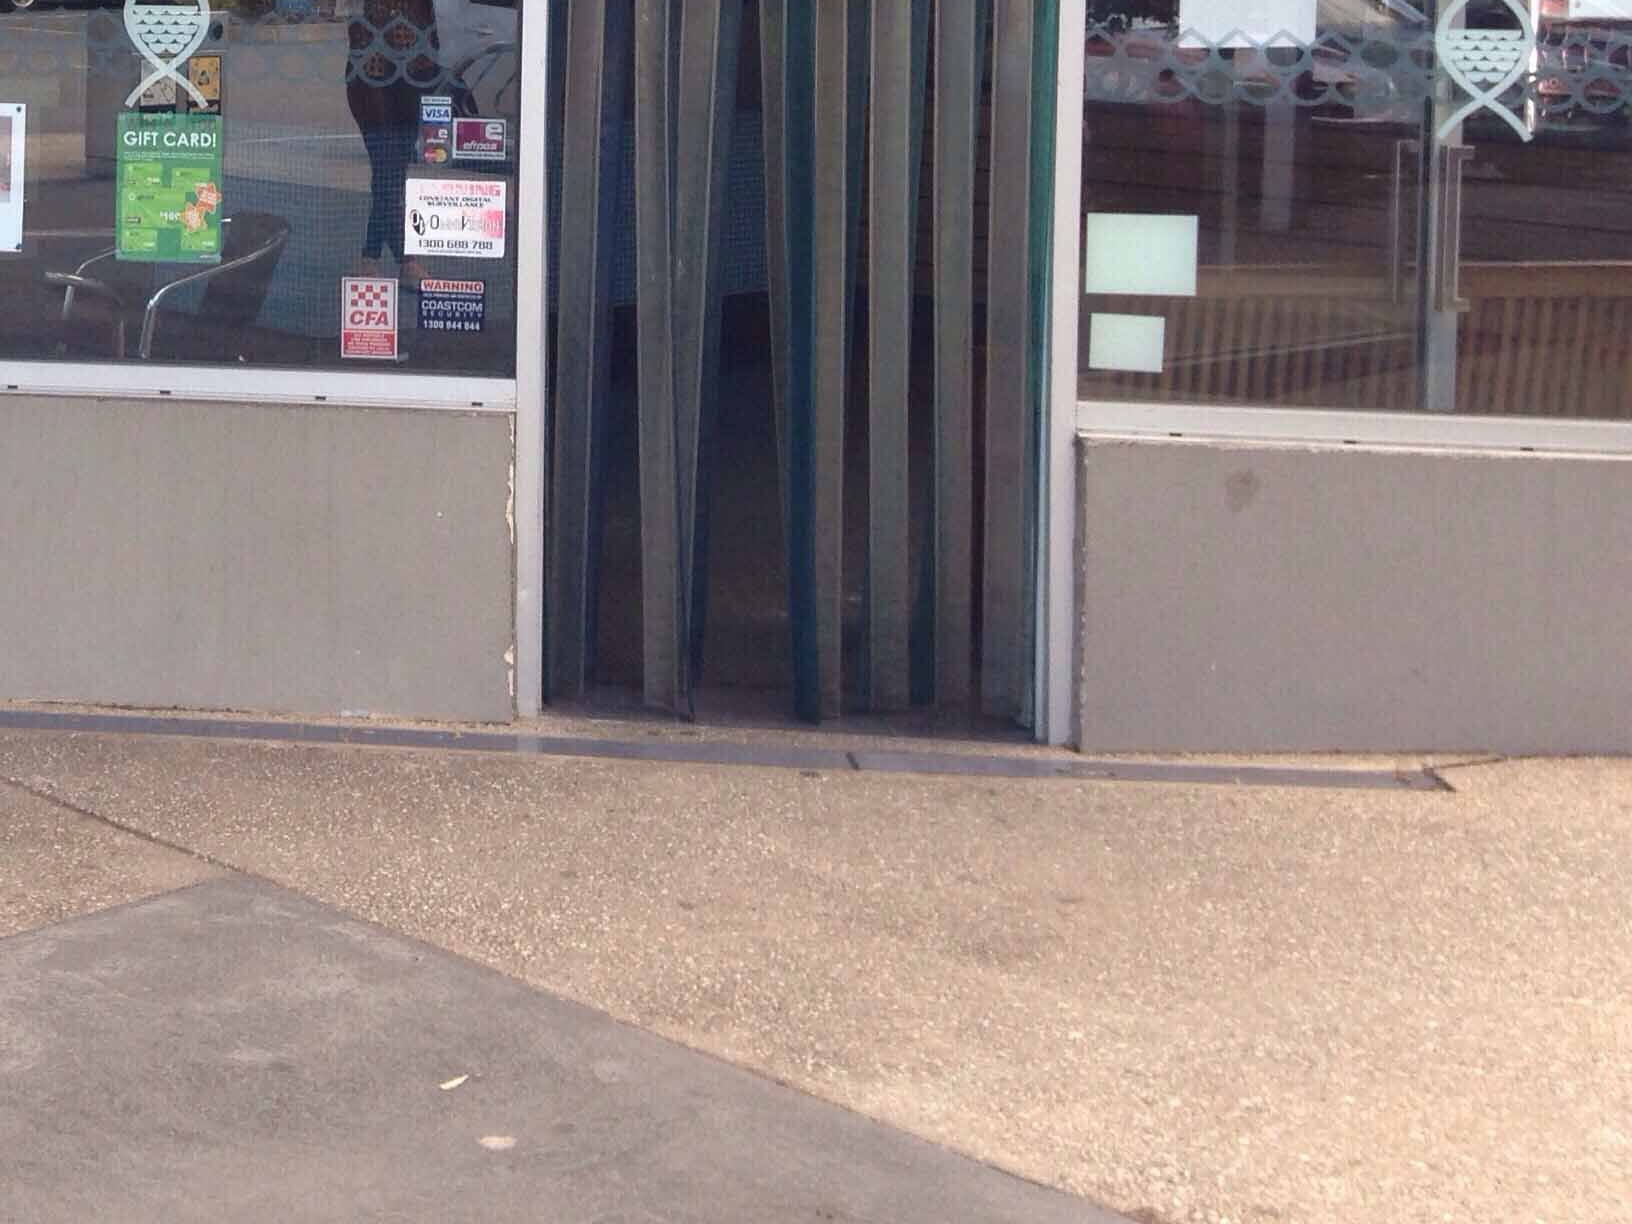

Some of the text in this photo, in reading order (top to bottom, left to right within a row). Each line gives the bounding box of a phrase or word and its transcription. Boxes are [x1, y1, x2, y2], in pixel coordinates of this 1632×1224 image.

[425, 109, 449, 119] VISA
[123, 130, 217, 148] GIFT CARD!
[423, 280, 483, 292] WARNING
[421, 300, 483, 311] COASTCOM
[350, 310, 389, 326] CFA
[422, 310, 482, 318] SECURITY
[423, 320, 444, 329] 1300
